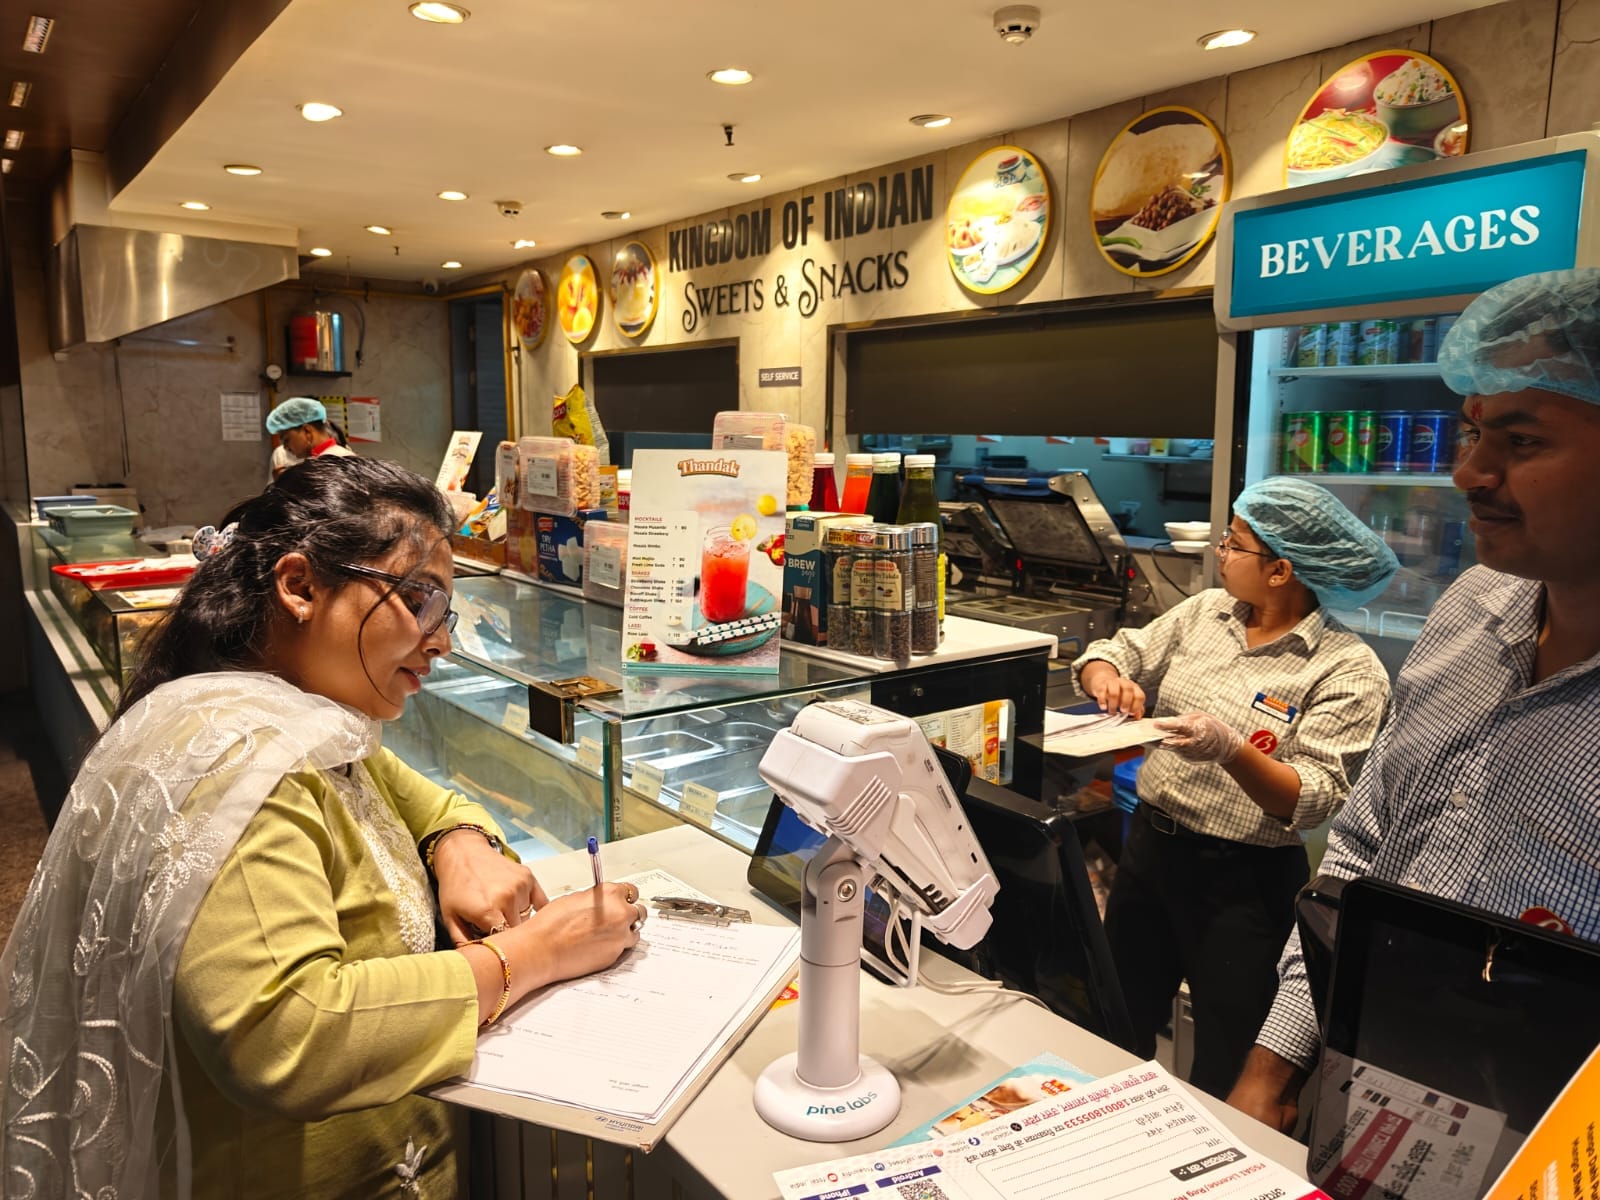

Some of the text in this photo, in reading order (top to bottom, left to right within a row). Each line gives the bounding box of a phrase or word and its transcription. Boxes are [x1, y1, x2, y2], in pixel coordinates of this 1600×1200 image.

[668, 164, 933, 273] KINGDOM OF INDIAN
[1259, 205, 1541, 278] BEVERAGES
[774, 274, 789, 308] &
[760, 370, 800, 382] SELF SERVICE
[679, 458, 740, 477] Thandak
[541, 535, 552, 544] DRY
[788, 558, 816, 570] BREW
[806, 1091, 878, 1115] pine labs
[1163, 1102, 1184, 1114] ईमेल
[1064, 1099, 1130, 1129] 18001805533
[1165, 1115, 1197, 1129] मोबाइल
[1193, 1126, 1209, 1135] पता
[1013, 1140, 1024, 1150] के
[1205, 1138, 1222, 1148] नाम
[1239, 1163, 1266, 1176] FSSAI
[891, 1169, 925, 1184] Android
[1186, 1173, 1239, 1197] License/Reg
[819, 1190, 851, 1200] iPhone
